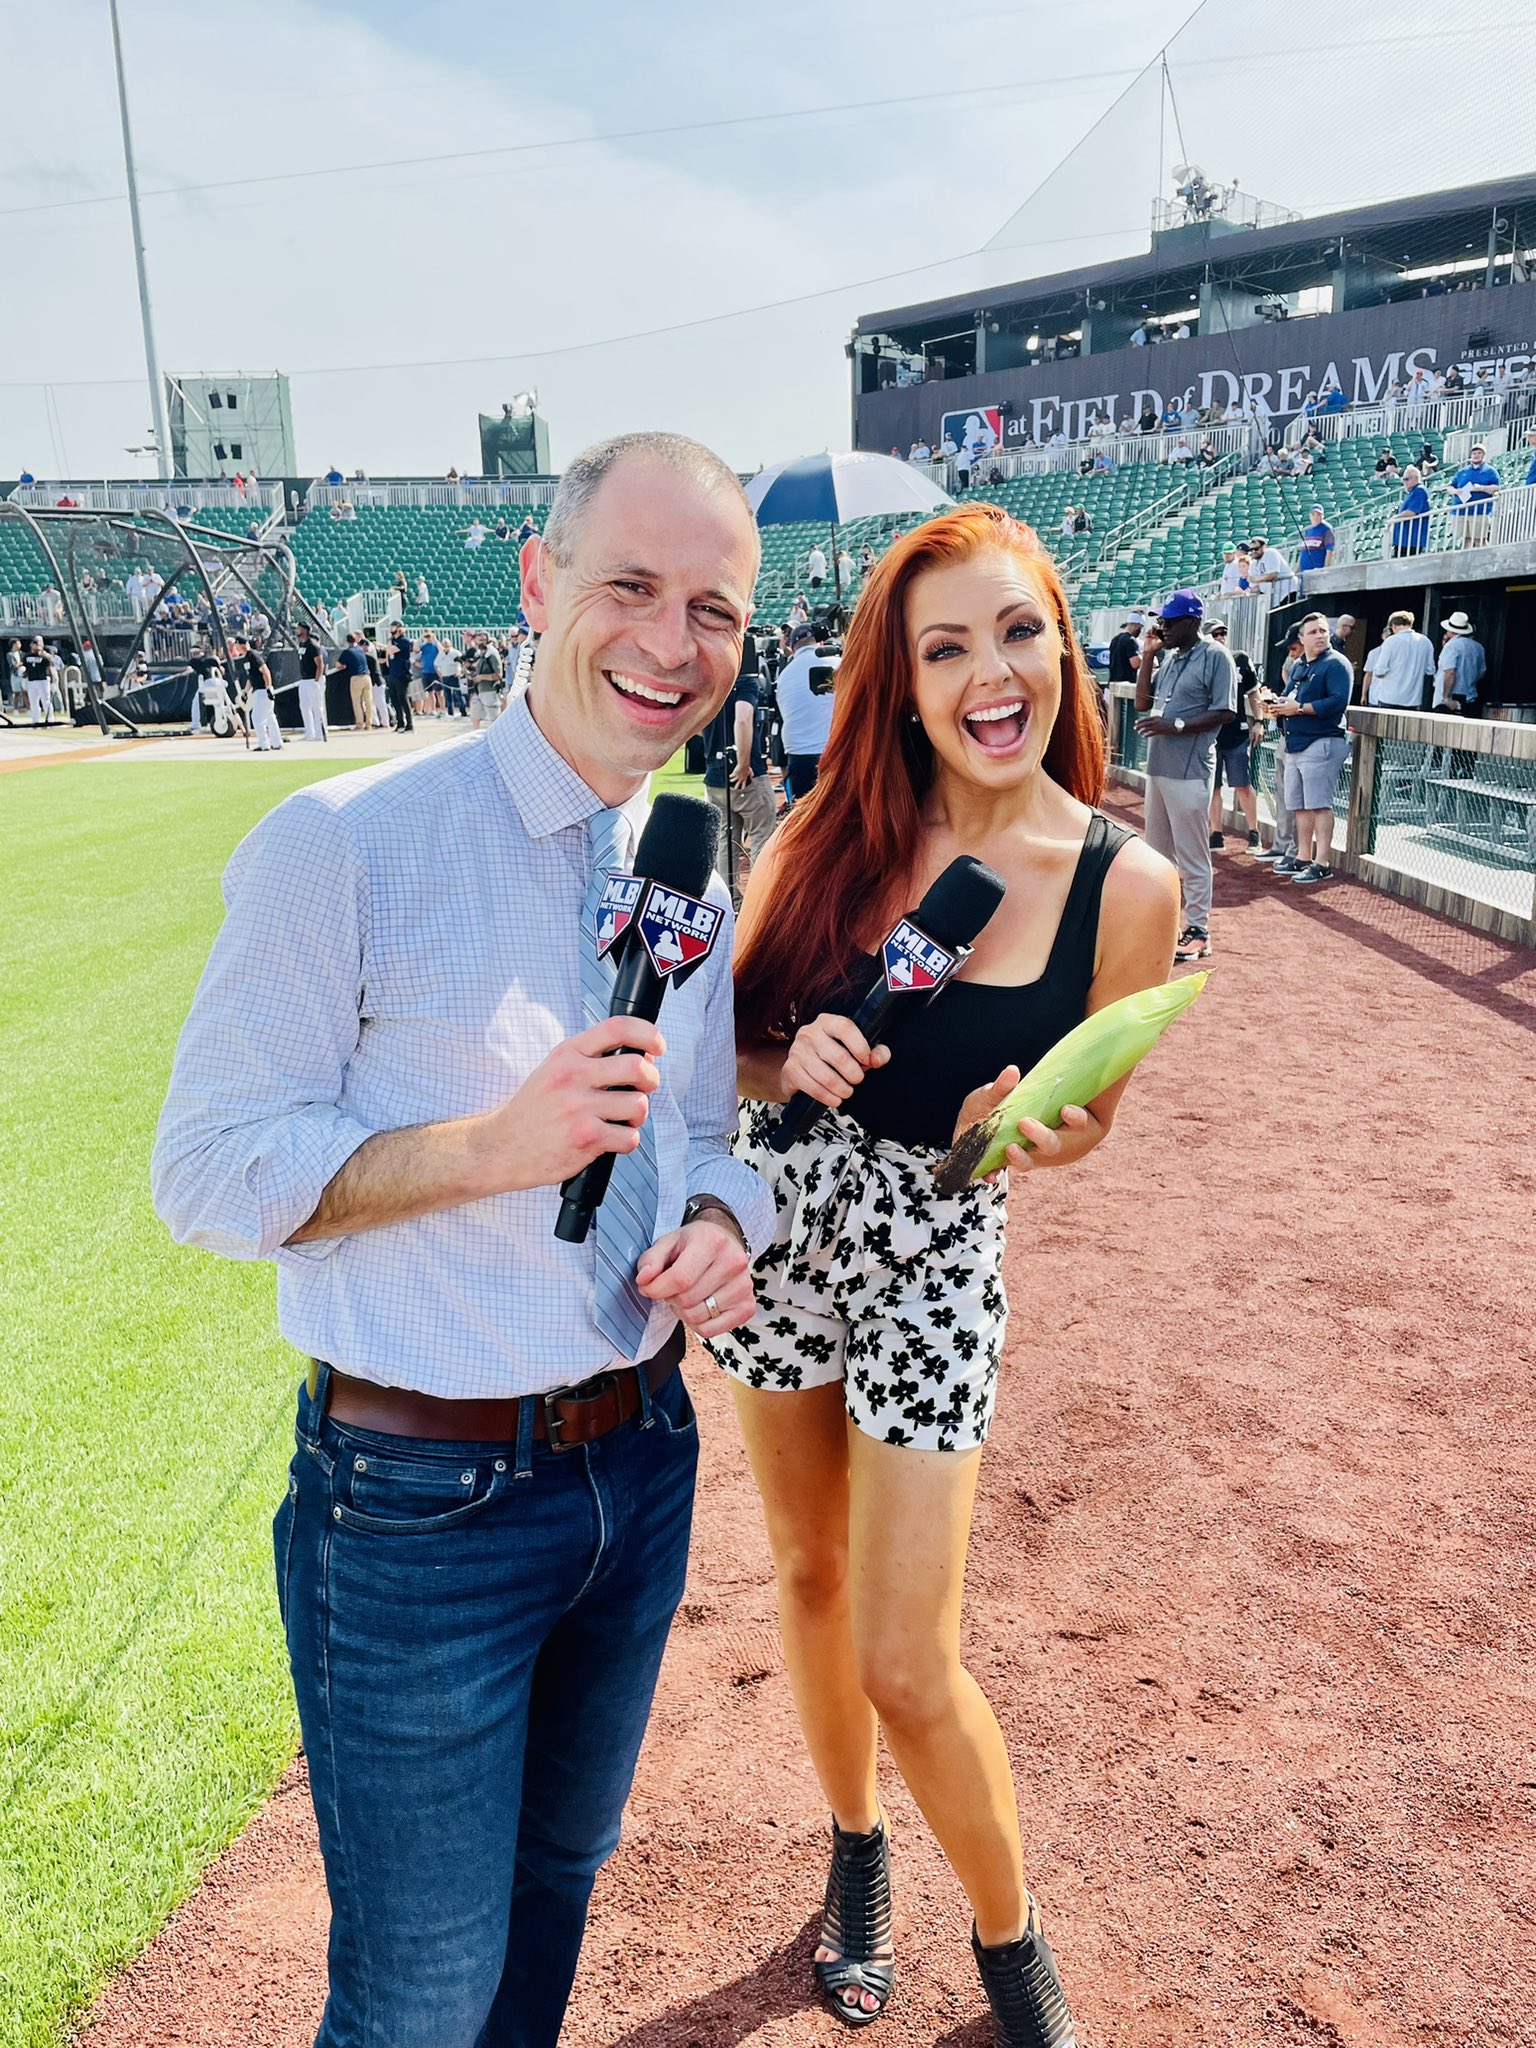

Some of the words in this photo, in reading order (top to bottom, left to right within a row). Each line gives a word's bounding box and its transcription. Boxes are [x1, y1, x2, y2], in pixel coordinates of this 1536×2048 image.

[1461, 342, 1529, 359] PRESENTED
[1446, 355, 1536, 386] GEIC
[1007, 414, 1027, 436] at
[1029, 389, 1163, 446] FIELD
[1168, 386, 1196, 415] of
[1198, 347, 1437, 419] DREAMS
[599, 901, 633, 913] NETWORK
[603, 880, 640, 905] MLB
[648, 888, 716, 933] MLB
[645, 911, 708, 942] NETWORK
[890, 938, 939, 979] NETWORK
[894, 924, 949, 972] MLB
